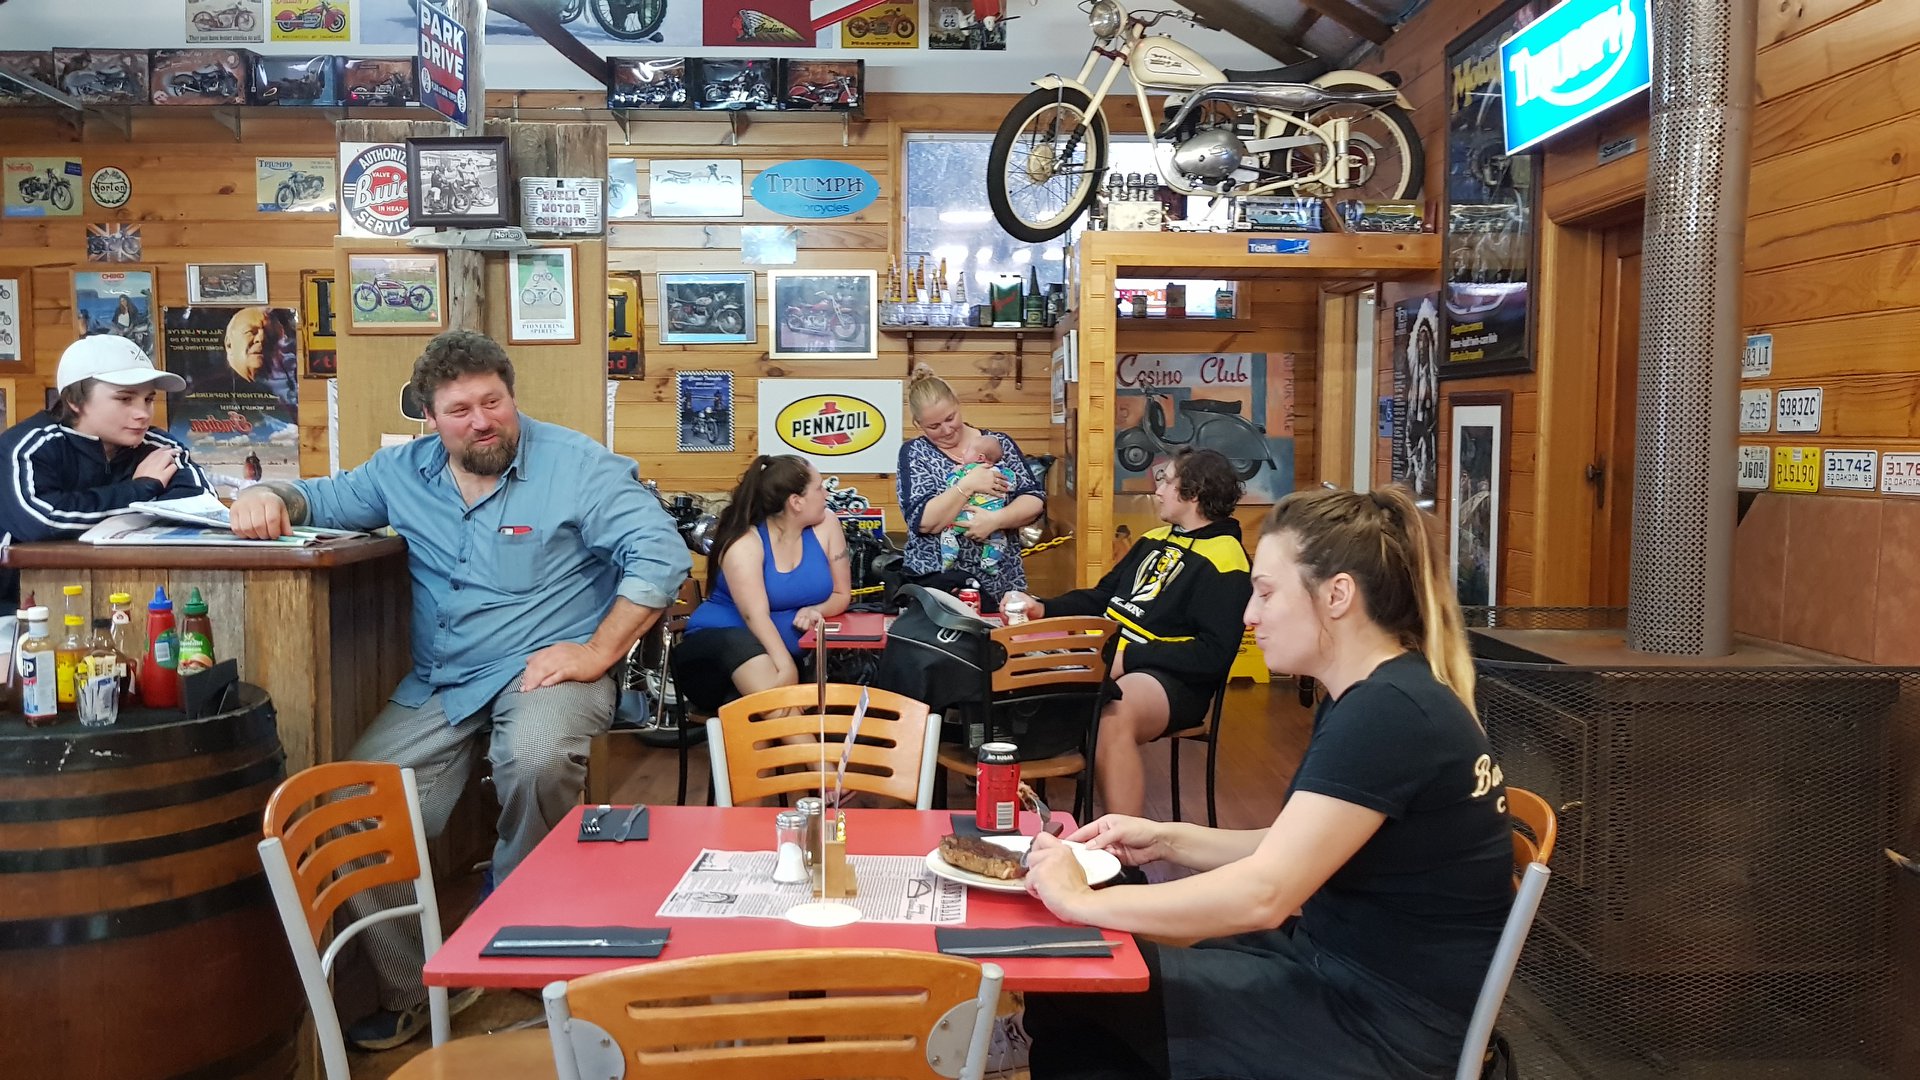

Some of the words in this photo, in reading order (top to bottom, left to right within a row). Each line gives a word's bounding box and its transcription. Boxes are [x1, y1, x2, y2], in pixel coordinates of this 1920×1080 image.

[421, 6, 464, 54] PARK
[755, 23, 785, 33] Indian
[943, 19, 956, 28] 66
[421, 34, 464, 81] DRIVE
[258, 160, 293, 170] TRIUMPH
[358, 147, 407, 170] AUTHORIZ
[92, 181, 127, 196] Norton
[352, 173, 408, 211] Buic
[765, 173, 864, 199] TRIUMPH
[543, 190, 579, 200] SHELL
[541, 203, 581, 213] MOTOR
[356, 211, 411, 233] SERVIC
[543, 217, 581, 227] SPIRIT
[494, 231, 521, 241] Norton
[1248, 243, 1277, 253] Toilet
[1200, 356, 1248, 384] Club
[1780, 397, 1816, 416] 9383ZC
[792, 411, 870, 438] PENNZOIL
[1828, 458, 1872, 472] 31742
